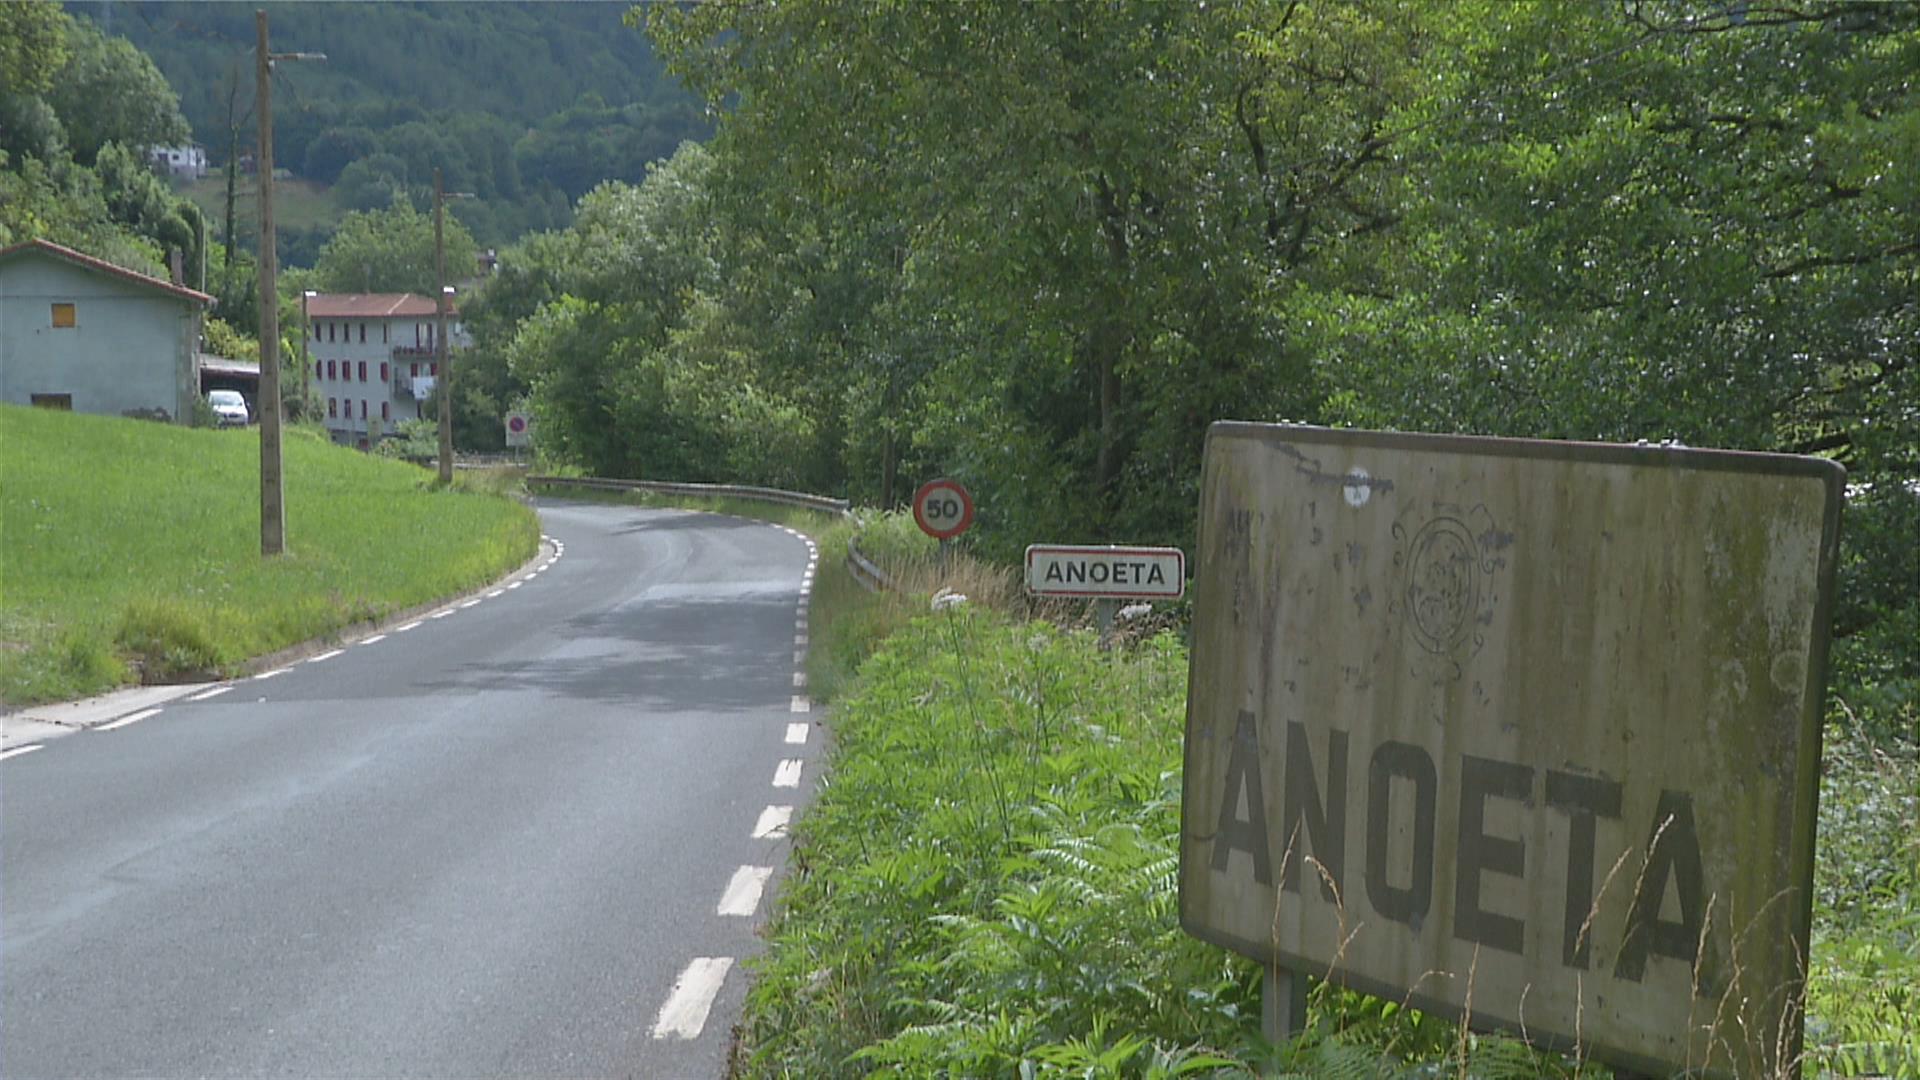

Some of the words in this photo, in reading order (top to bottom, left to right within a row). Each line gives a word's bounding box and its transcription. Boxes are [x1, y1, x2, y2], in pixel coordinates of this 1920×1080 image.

[927, 500, 958, 519] 50
[1046, 561, 1165, 585] ANOETA
[1209, 708, 1713, 992] ANOETA
